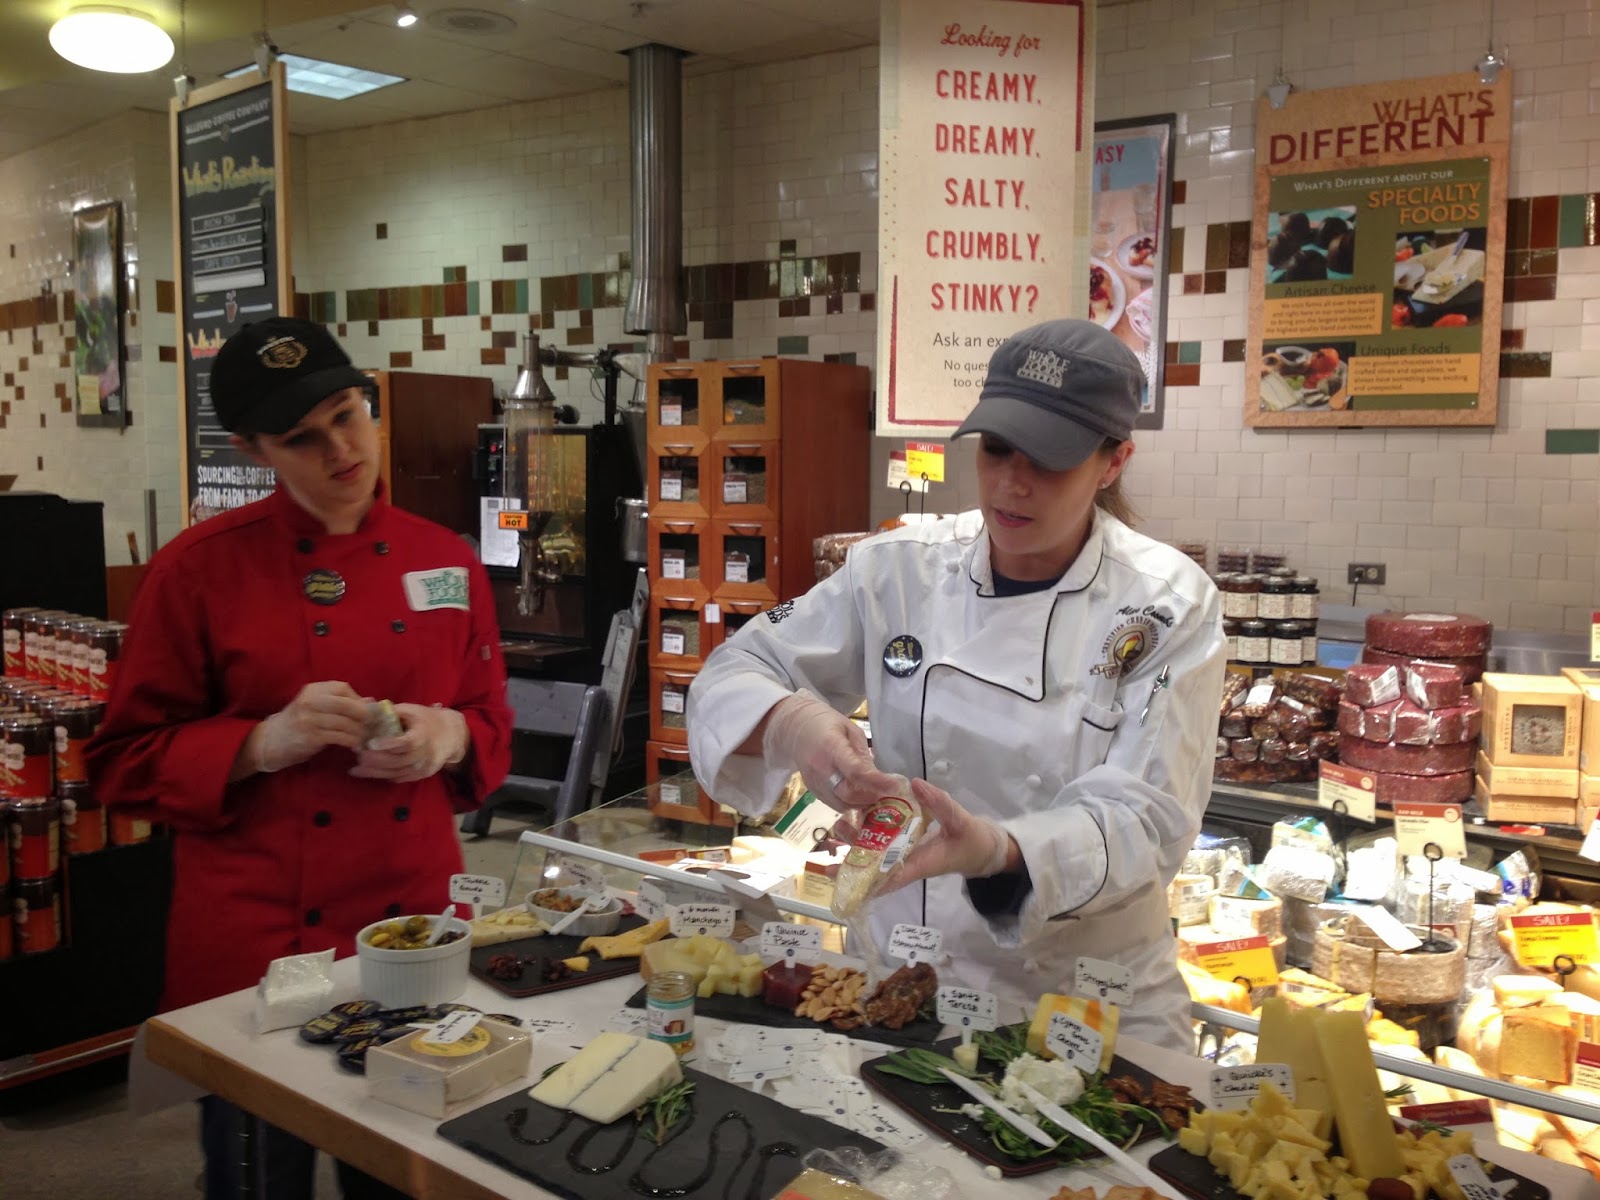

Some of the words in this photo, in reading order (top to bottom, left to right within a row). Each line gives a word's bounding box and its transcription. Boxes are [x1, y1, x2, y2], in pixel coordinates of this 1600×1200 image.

[940, 23, 1012, 57] Looking
[1014, 34, 1041, 57] for
[213, 110, 236, 126] COFFEE
[236, 98, 269, 118] COMPANY
[1373, 89, 1494, 125] WHAT'S
[1270, 110, 1494, 165] DIFFERENT
[1368, 182, 1481, 209] SPECIALTY
[1400, 203, 1481, 226] FOODS
[931, 282, 1040, 313] STINKY?
[1284, 286, 1328, 297] Artisan
[1331, 283, 1377, 295] Cheese
[933, 331, 960, 347] Ask
[964, 336, 982, 347] an
[1360, 344, 1407, 359] Unique
[1411, 341, 1451, 354] Foods
[944, 360, 961, 370] No
[1023, 359, 1063, 379] FOODS
[1029, 350, 1071, 371] WHOLE
[953, 378, 972, 388] too
[1018, 369, 1061, 387] MARKET
[197, 465, 236, 484] SOURCING
[245, 466, 276, 485] COFFEE
[198, 486, 221, 508] FROM
[222, 487, 245, 508] FARM
[505, 519, 522, 527] HOT
[858, 828, 892, 845] Brie
[683, 916, 722, 928] Manchego
[1532, 914, 1570, 926] SALE!
[772, 934, 801, 947] Paste
[1216, 940, 1249, 952] SALE!
[951, 989, 980, 1003] Santa
